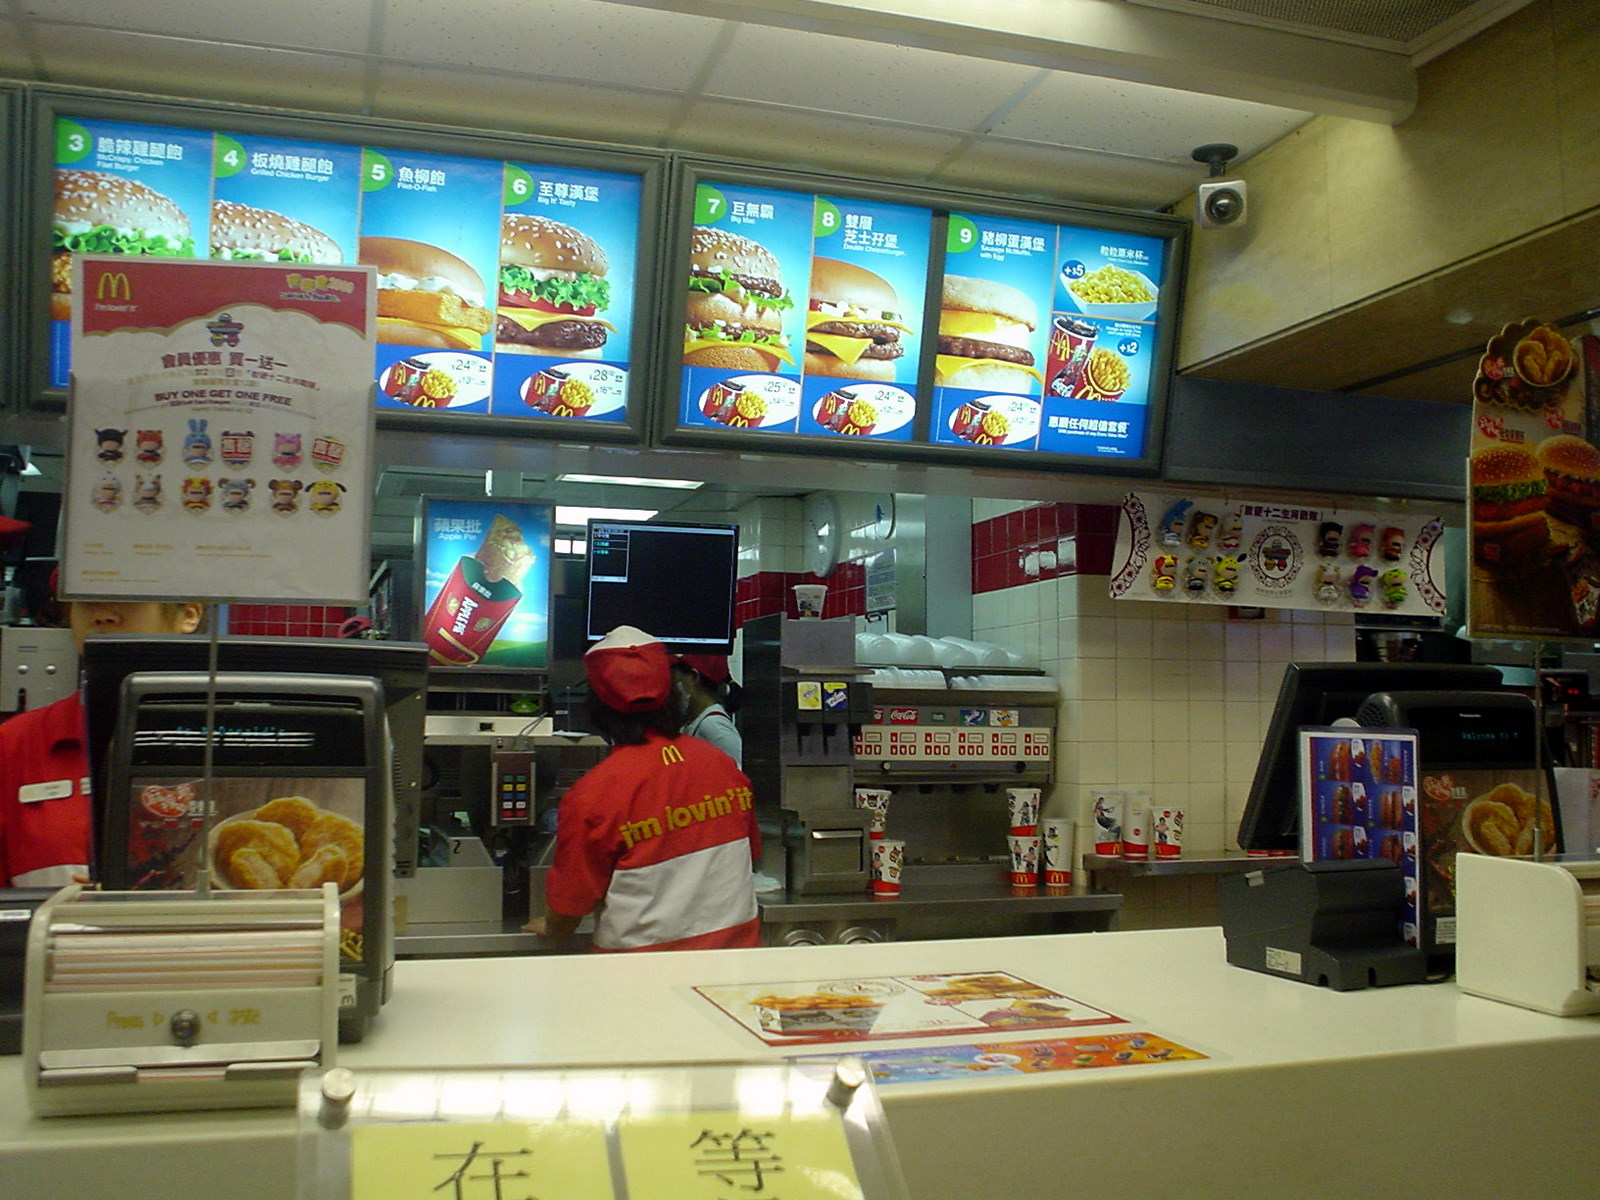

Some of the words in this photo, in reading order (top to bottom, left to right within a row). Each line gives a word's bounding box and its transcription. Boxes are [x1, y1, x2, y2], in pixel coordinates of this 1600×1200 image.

[68, 134, 84, 152] 3
[133, 157, 164, 166] Chicken
[223, 149, 239, 167] 4
[250, 167, 275, 177] Grilled
[275, 170, 304, 179] Chicken
[305, 173, 330, 182] Burger
[370, 163, 387, 181] 5
[512, 178, 528, 195] 6
[707, 197, 721, 214] 7
[822, 211, 836, 227] 8
[960, 228, 973, 244] 9
[229, 351, 289, 371] 買一送一
[155, 392, 180, 402] BUY
[182, 389, 206, 399] ONE
[209, 389, 232, 399] GET
[235, 390, 261, 401] ONE
[262, 395, 292, 407] FREE
[438, 533, 463, 541] Apple
[619, 817, 663, 849] i'm
[665, 789, 735, 831] lovin'
[736, 786, 752, 812] it
[689, 1128, 785, 1192] 等
